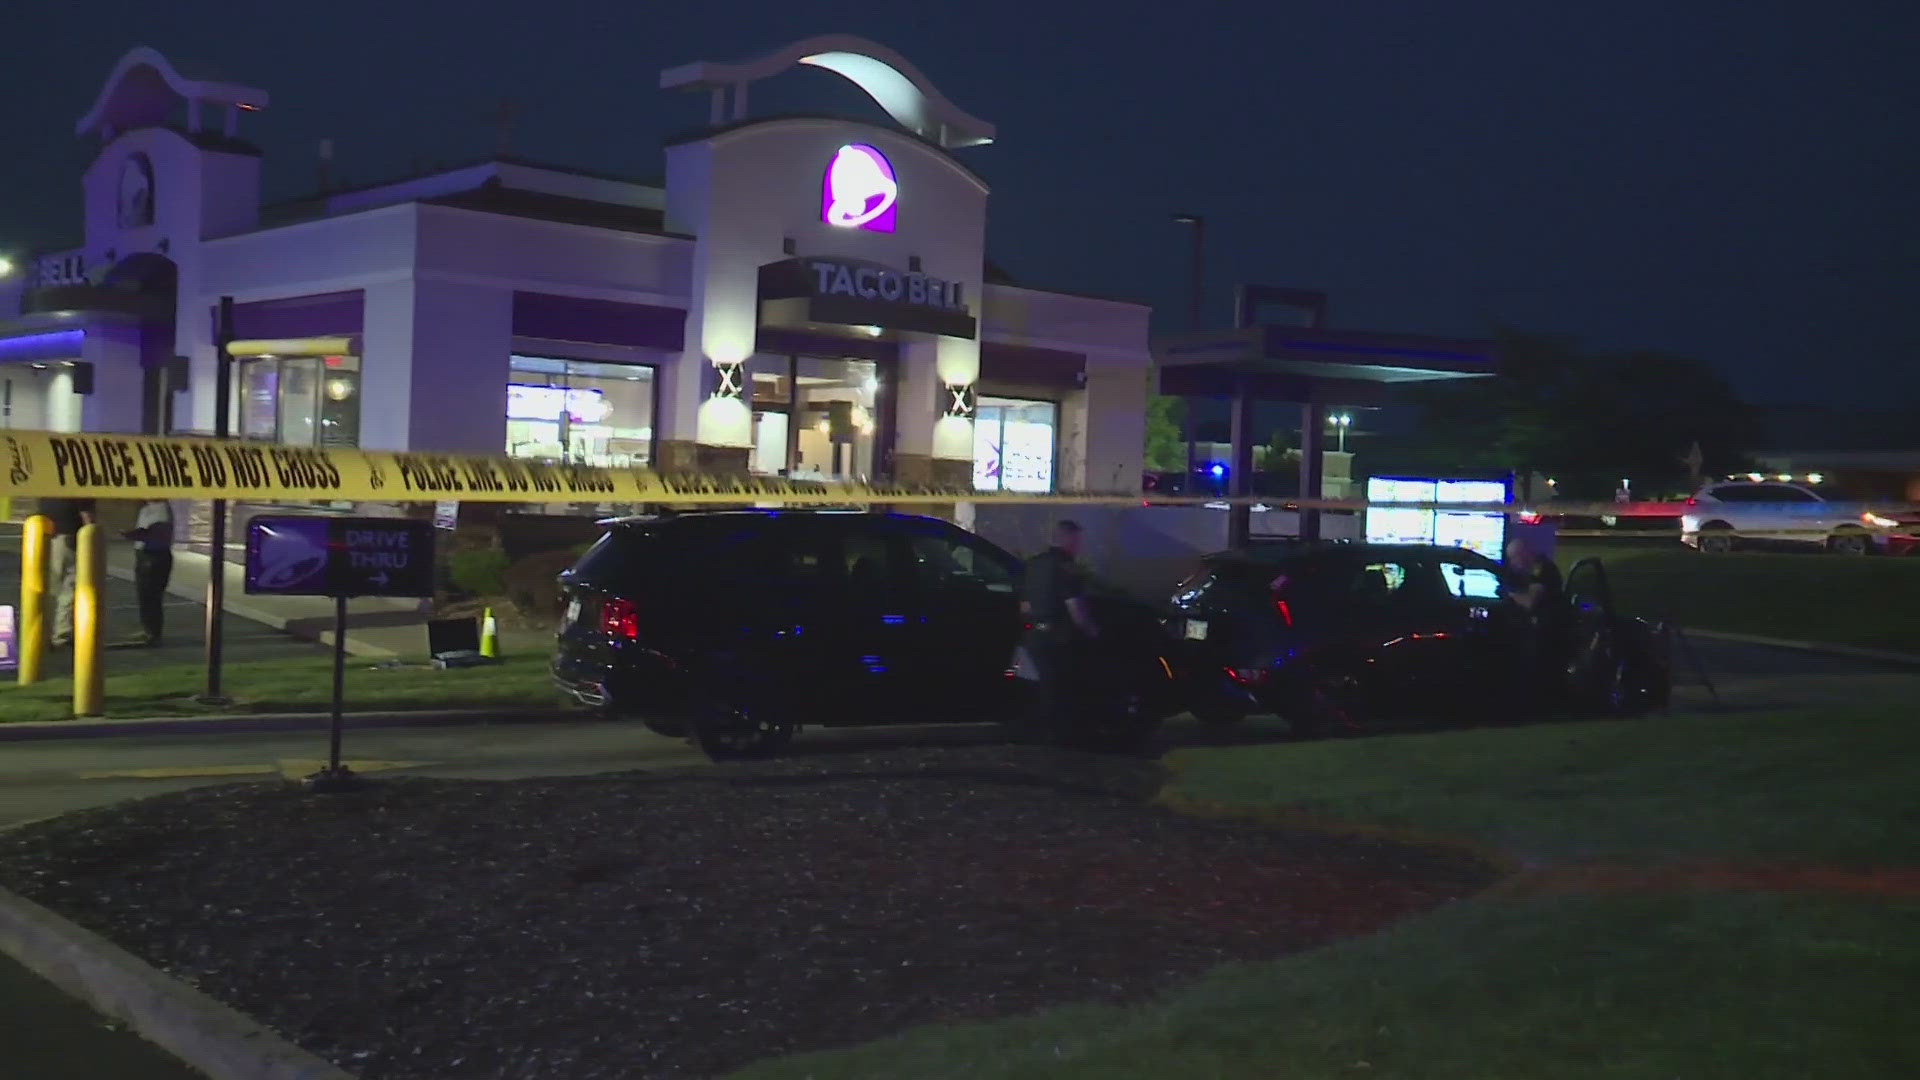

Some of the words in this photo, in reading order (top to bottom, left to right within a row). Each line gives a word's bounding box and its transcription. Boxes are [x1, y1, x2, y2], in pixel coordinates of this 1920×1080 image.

[812, 262, 903, 301] TACO
[908, 273, 966, 310] BELL
[51, 438, 138, 487] POLICE
[138, 442, 193, 487] LINE
[192, 445, 227, 488] DO
[226, 447, 271, 489] NOT
[270, 448, 341, 490] CROSS
[345, 530, 409, 548] DRIVE
[349, 552, 408, 568] THRU
